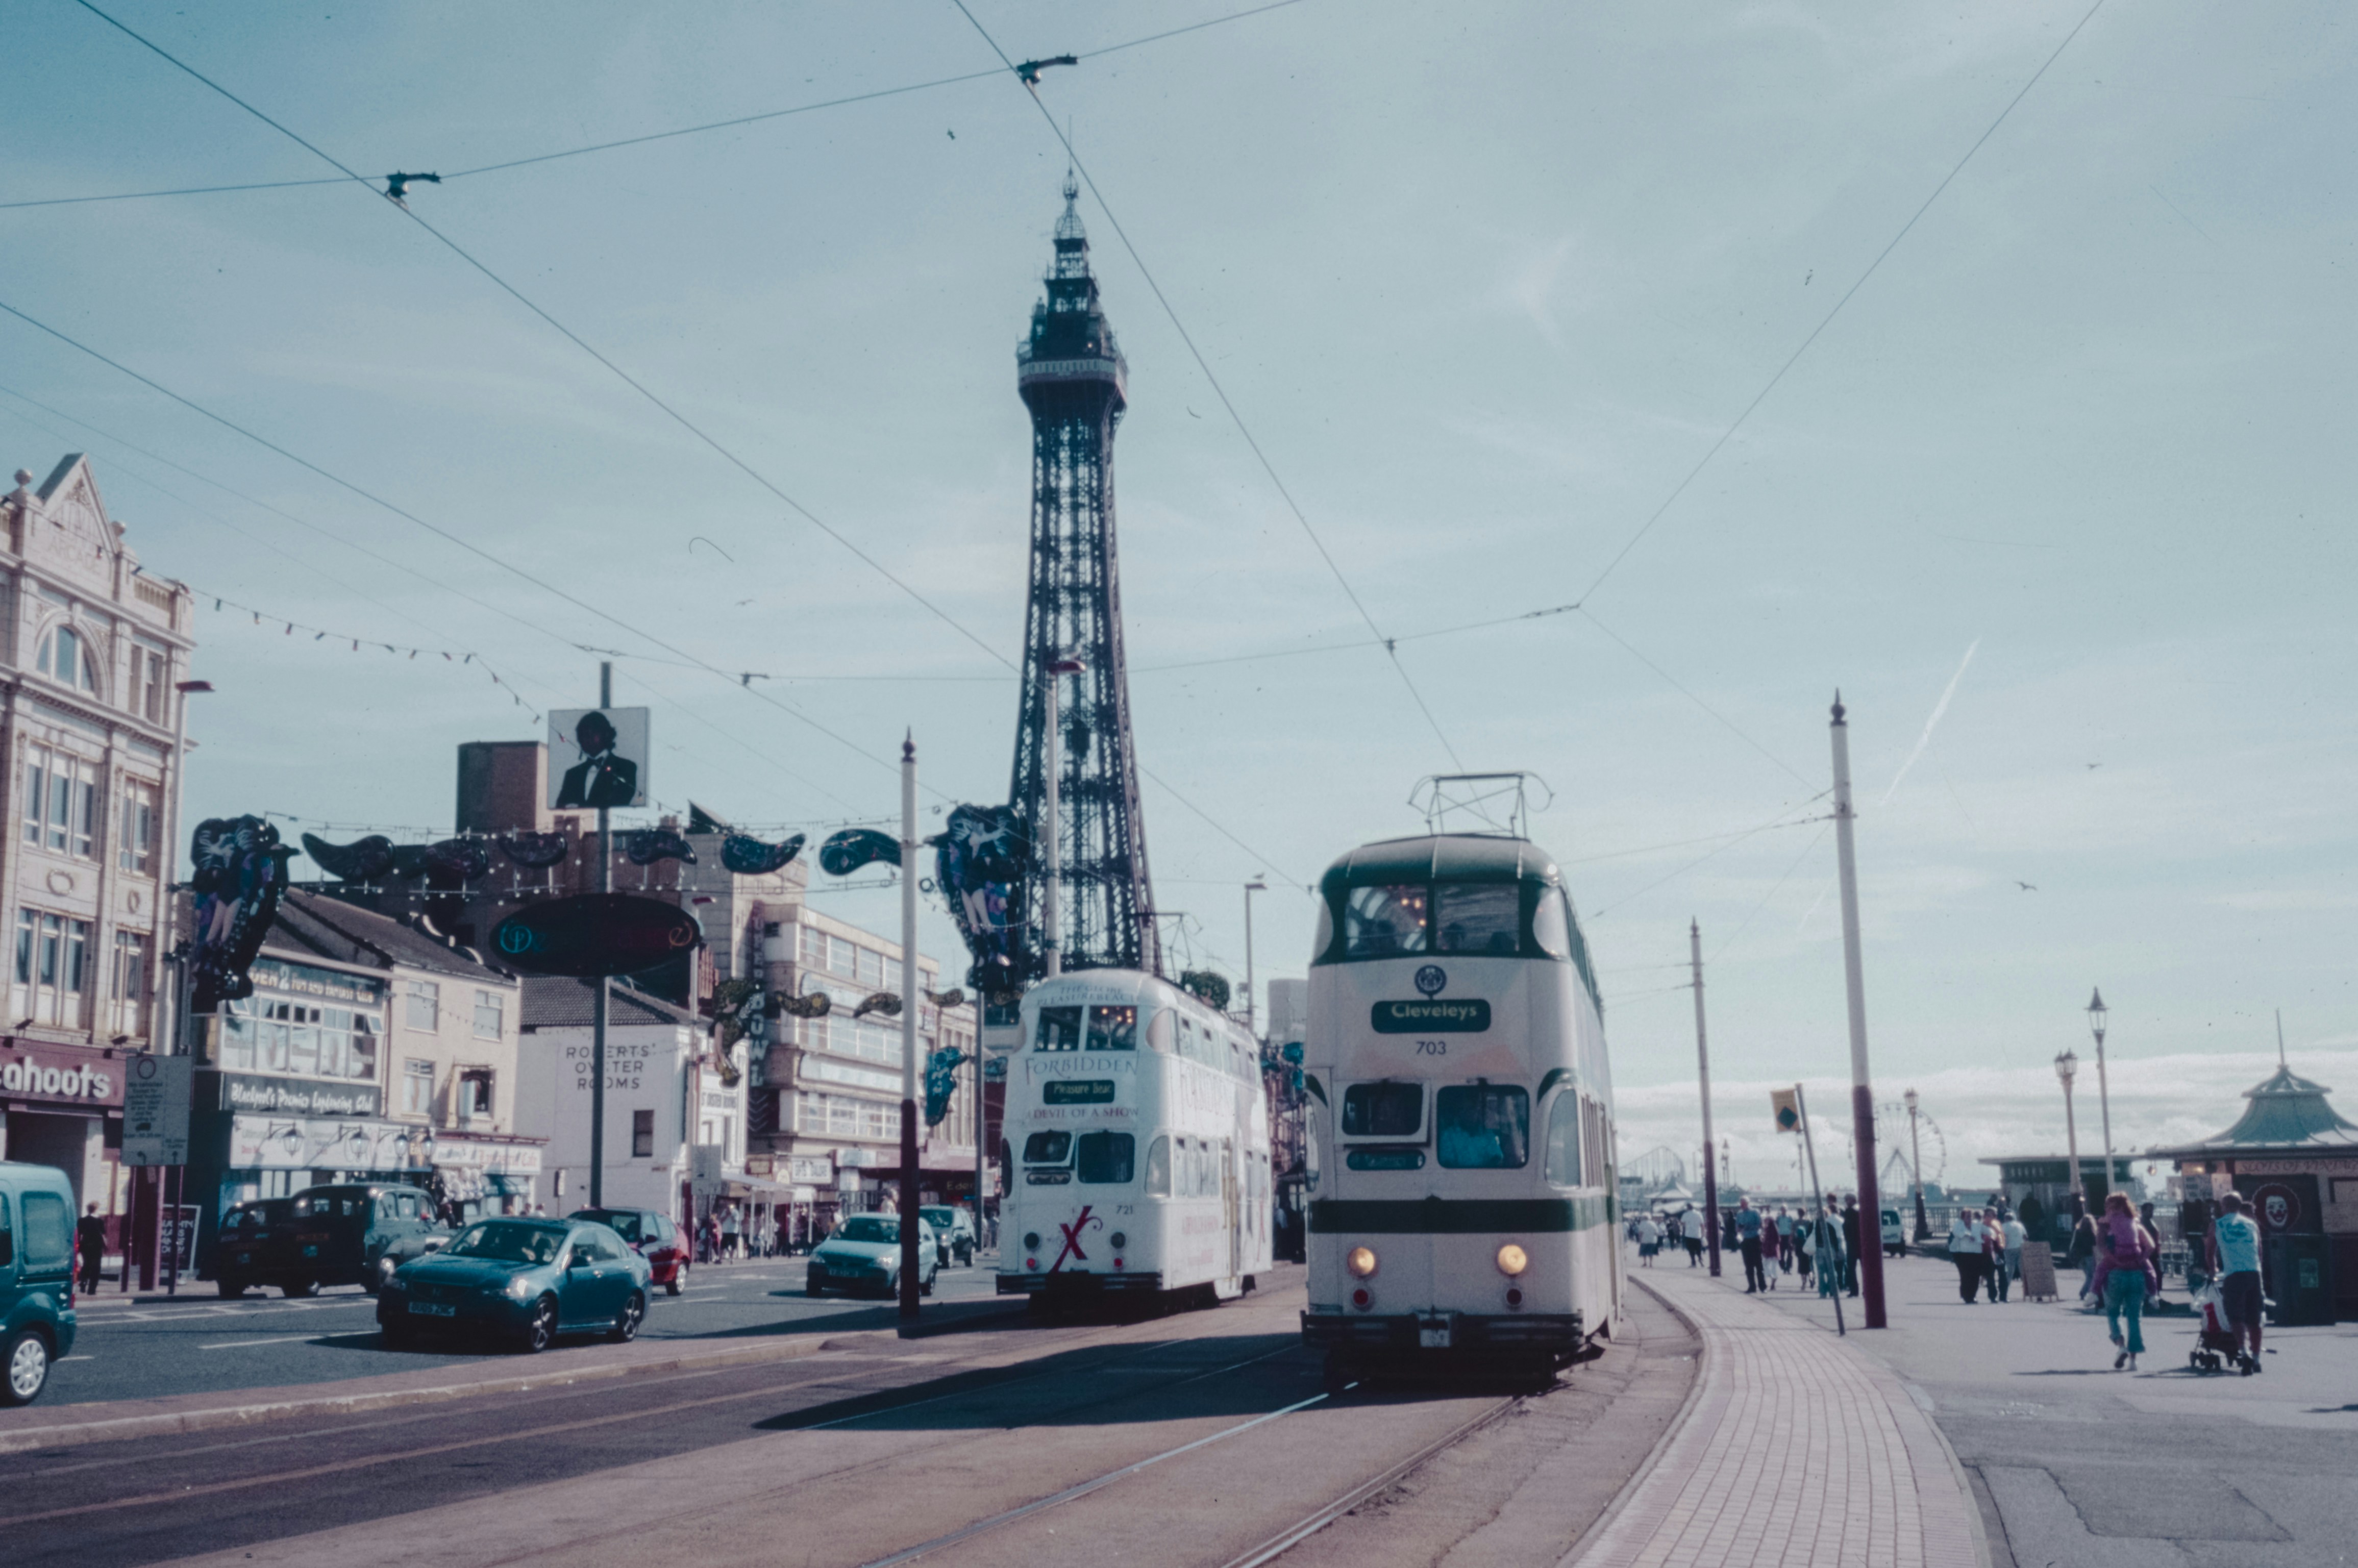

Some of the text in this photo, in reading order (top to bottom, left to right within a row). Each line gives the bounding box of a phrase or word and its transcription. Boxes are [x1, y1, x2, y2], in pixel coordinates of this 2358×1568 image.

[1392, 1003, 1477, 1021] Cleveleys
[566, 1043, 656, 1059] ROERTS'
[1416, 1040, 1446, 1055] 703
[575, 1060, 643, 1074] OYTER
[1025, 1044, 1140, 1085] FORBIDDEN
[0, 1056, 111, 1099] ahoots
[1053, 1082, 1089, 1094] Pleasure
[1034, 1108, 1065, 1119] DEVIL
[1071, 1108, 1087, 1117] OF
[1091, 1107, 1100, 1117] A
[1102, 1105, 1139, 1117] SHOW
[1116, 1205, 1133, 1215] 721
